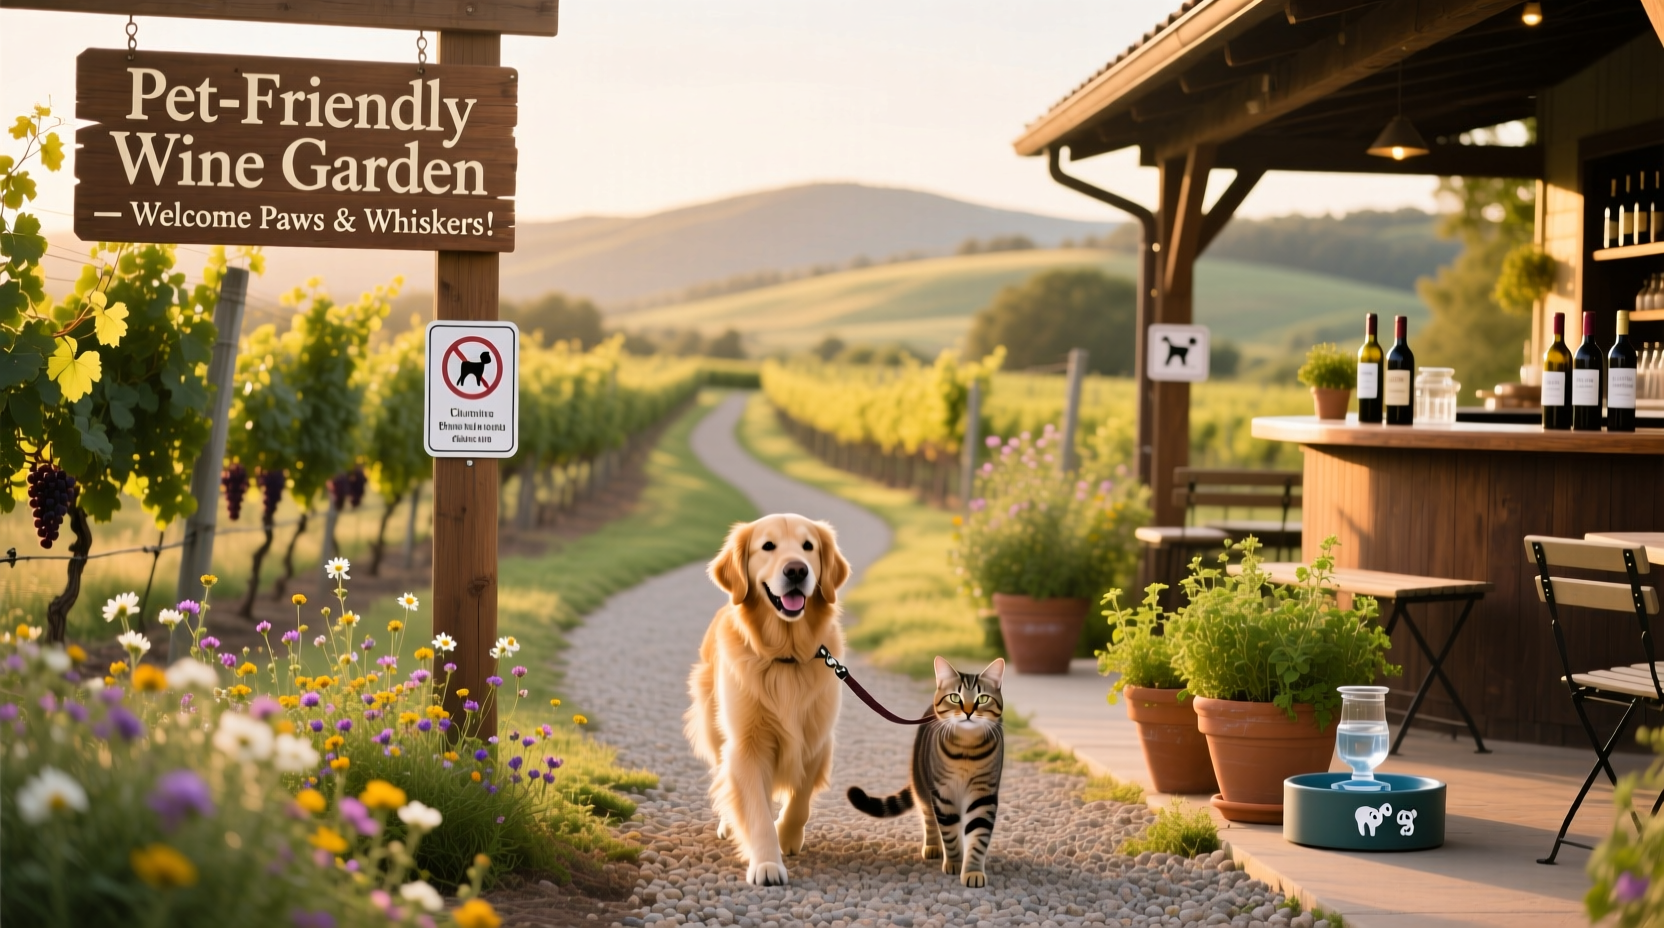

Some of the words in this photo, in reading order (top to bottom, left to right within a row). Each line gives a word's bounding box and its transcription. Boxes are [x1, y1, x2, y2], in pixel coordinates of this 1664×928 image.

[125, 67, 478, 148] Pet-Friendly
[109, 130, 265, 189] Wine
[281, 137, 488, 195] Garden
[130, 201, 251, 229] Welcome
[259, 205, 325, 231] Paws
[333, 208, 356, 233] &
[363, 208, 495, 237] Whiskers!
